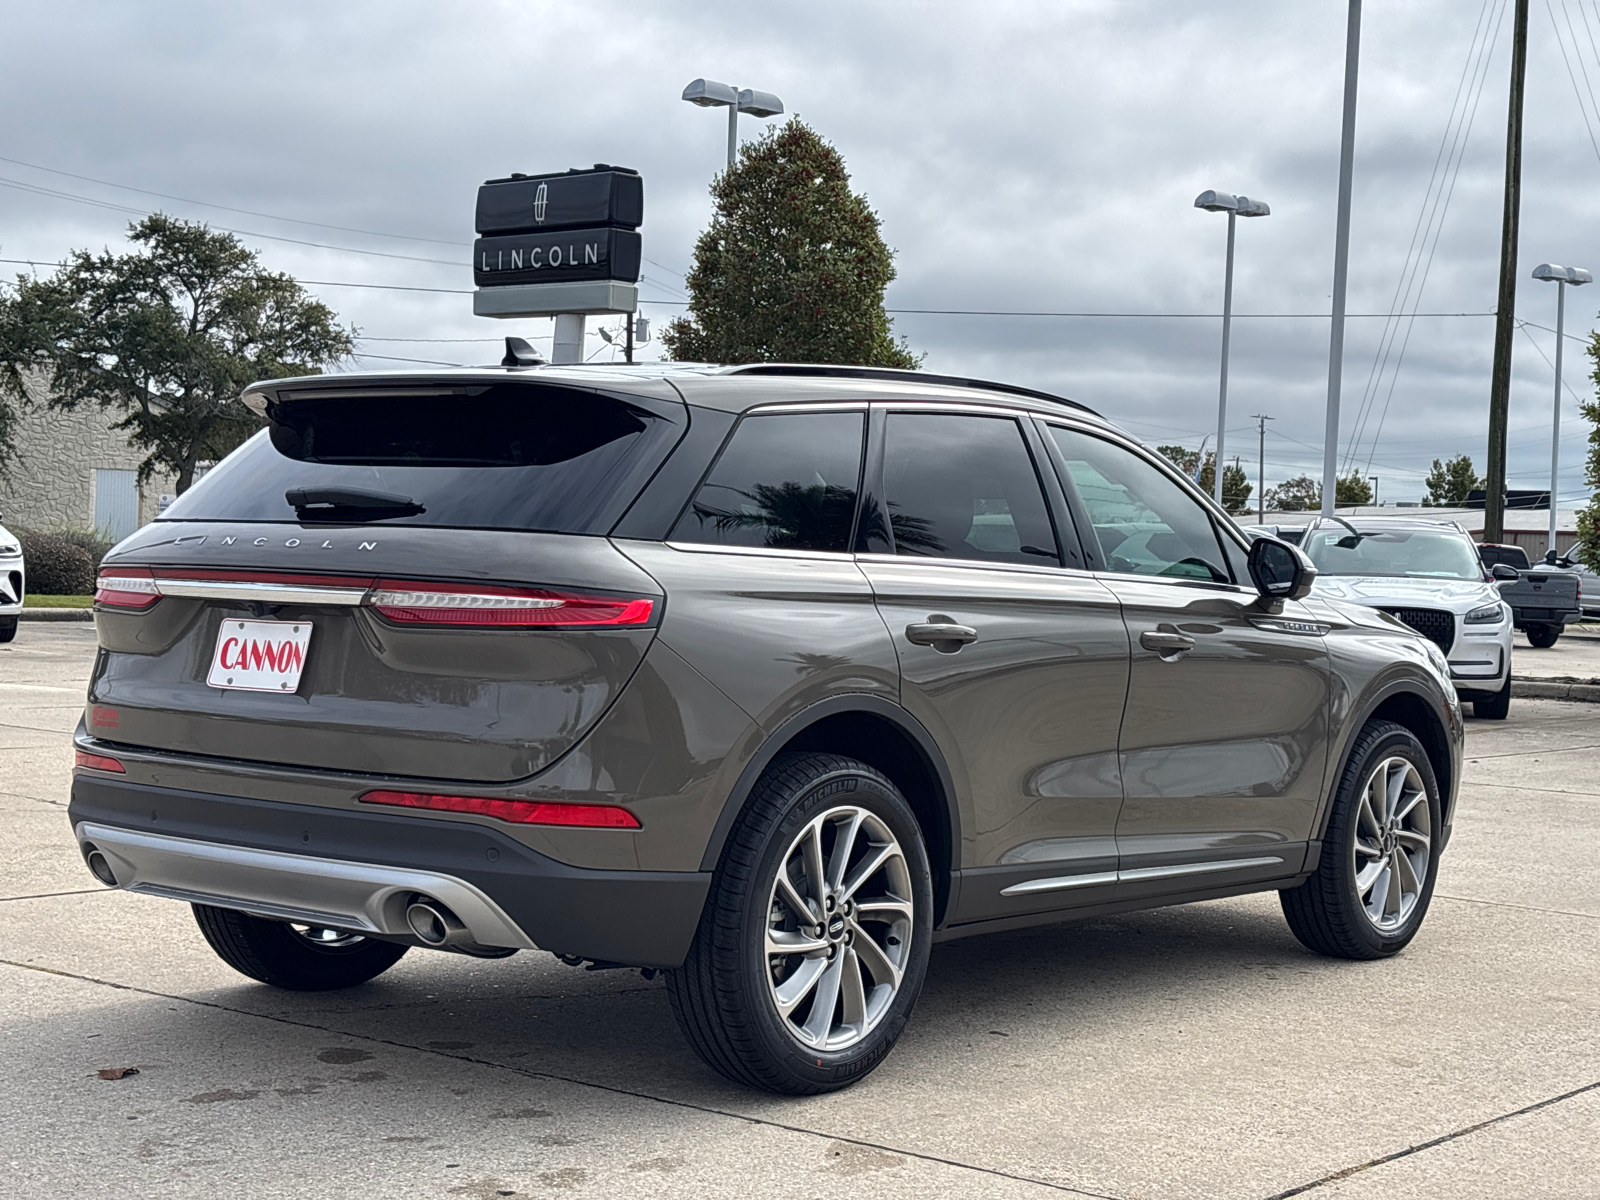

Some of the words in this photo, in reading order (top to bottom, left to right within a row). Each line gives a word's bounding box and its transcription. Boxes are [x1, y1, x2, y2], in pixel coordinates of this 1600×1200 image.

[482, 243, 598, 271] LINCOLN
[174, 536, 377, 550] LINCOLN
[220, 637, 305, 673] CANNON
[803, 780, 856, 810] MICHELIN
